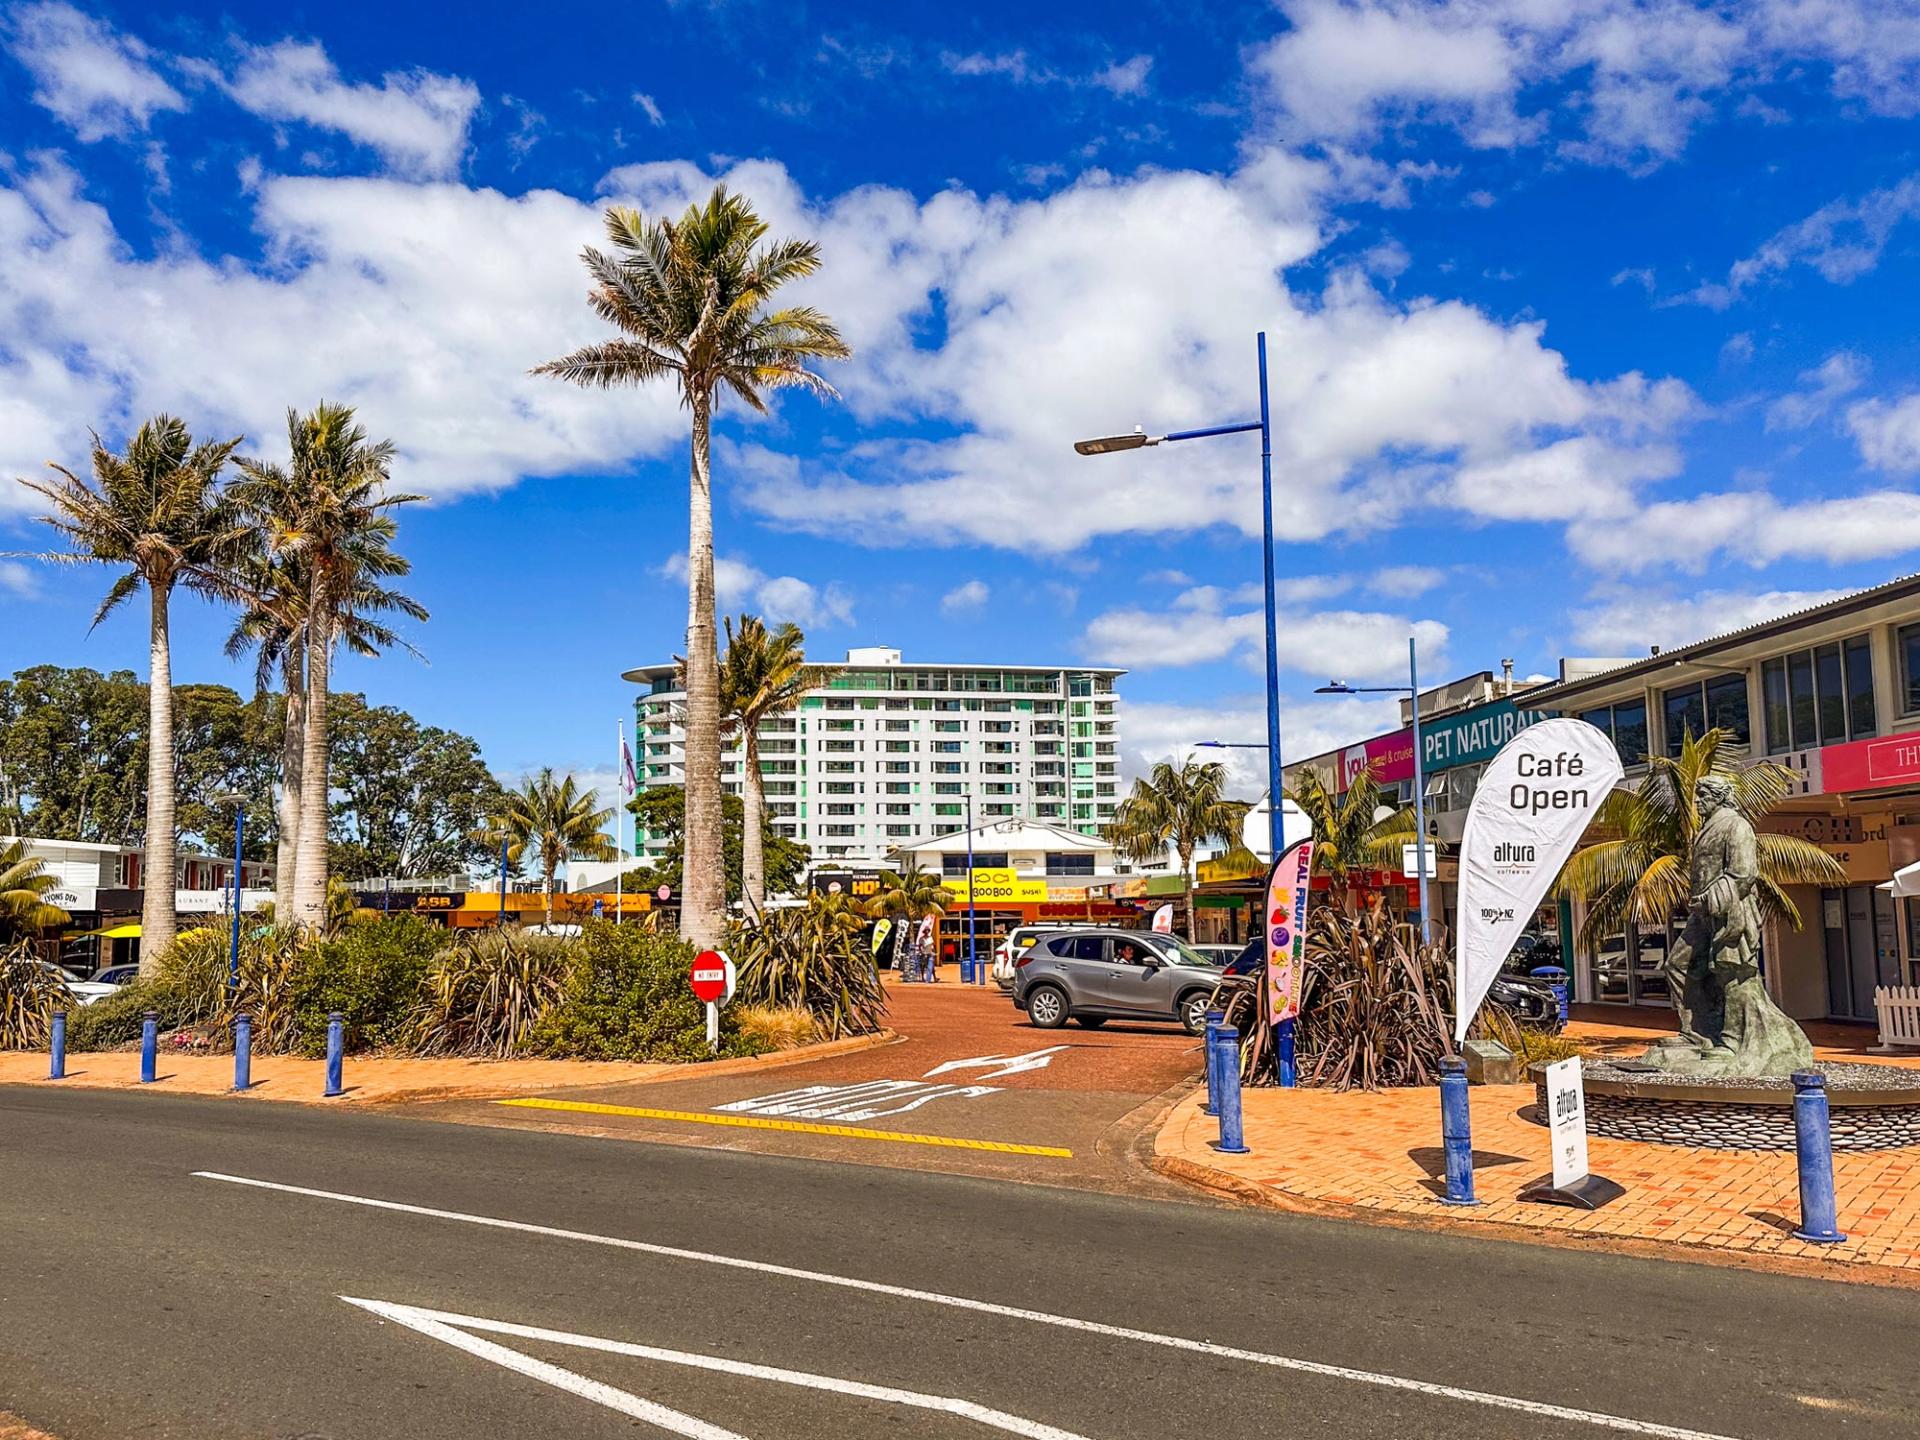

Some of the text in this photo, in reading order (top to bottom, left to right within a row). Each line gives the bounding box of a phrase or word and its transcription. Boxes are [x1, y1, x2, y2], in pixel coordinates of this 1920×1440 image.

[1425, 729, 1452, 762] PET
[1895, 745, 1920, 766] TH
[1518, 752, 1584, 777] Café
[1510, 784, 1588, 816] Open
[1296, 846, 1311, 883] REAL
[1494, 842, 1535, 862] altura
[64, 893, 78, 904] DEN
[417, 896, 451, 906] ASB
[1294, 887, 1307, 931] FRUIT
[1504, 909, 1514, 918] NZ
[1556, 1088, 1578, 1118] altura
